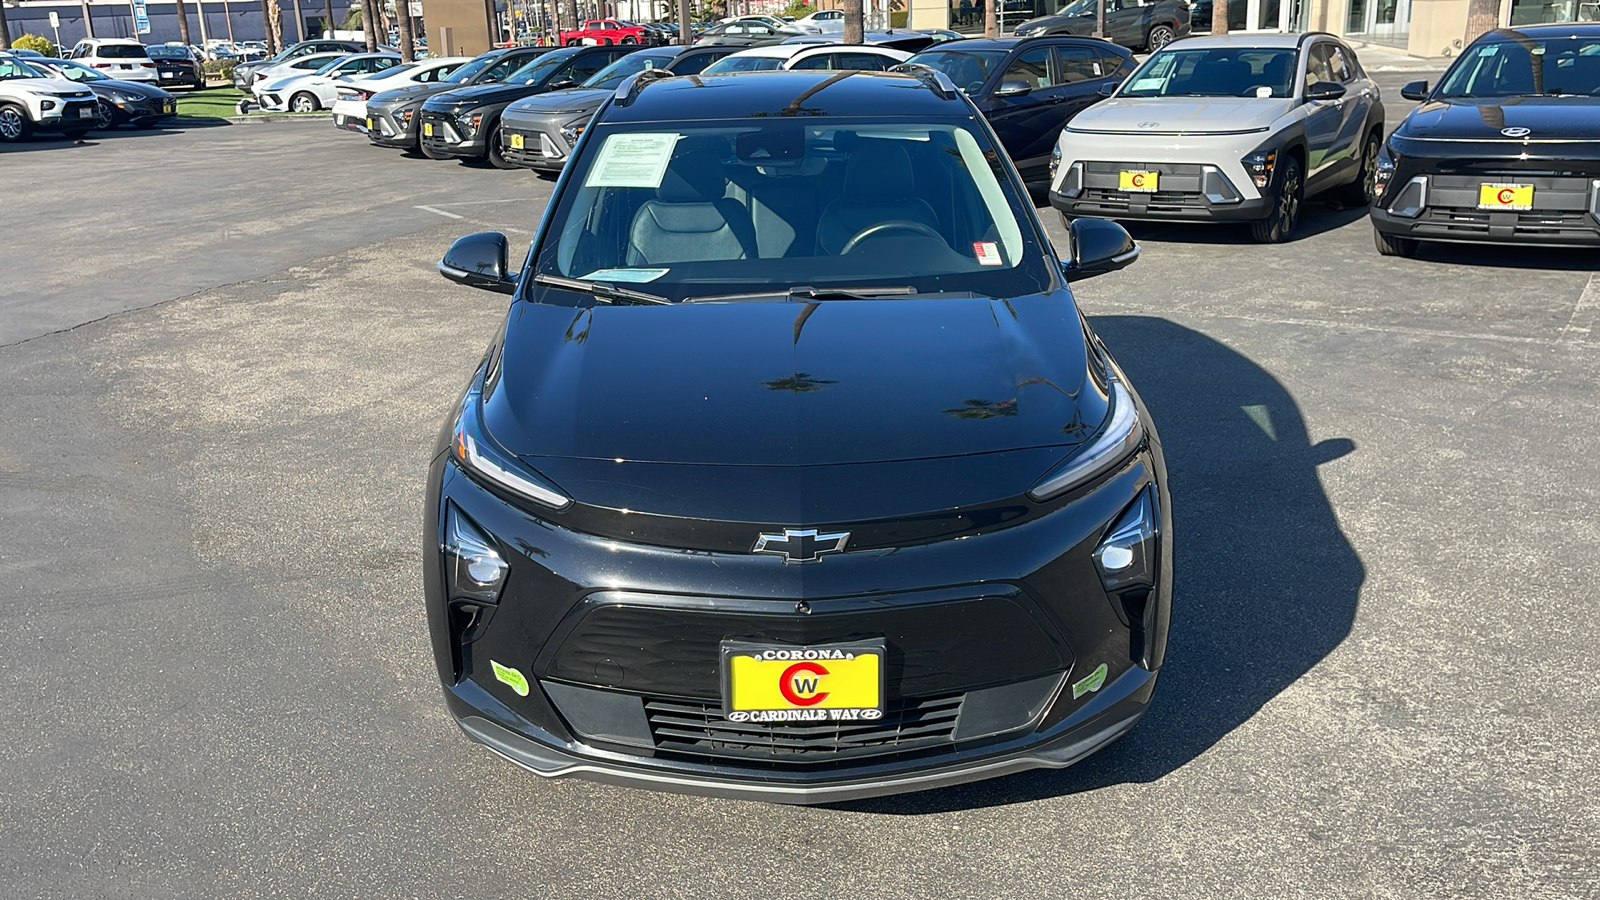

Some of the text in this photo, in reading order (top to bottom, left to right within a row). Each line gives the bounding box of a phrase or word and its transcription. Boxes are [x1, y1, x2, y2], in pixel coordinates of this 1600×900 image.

[763, 650, 844, 660] CORONA
[750, 708, 861, 722] CARDINALE WAY
